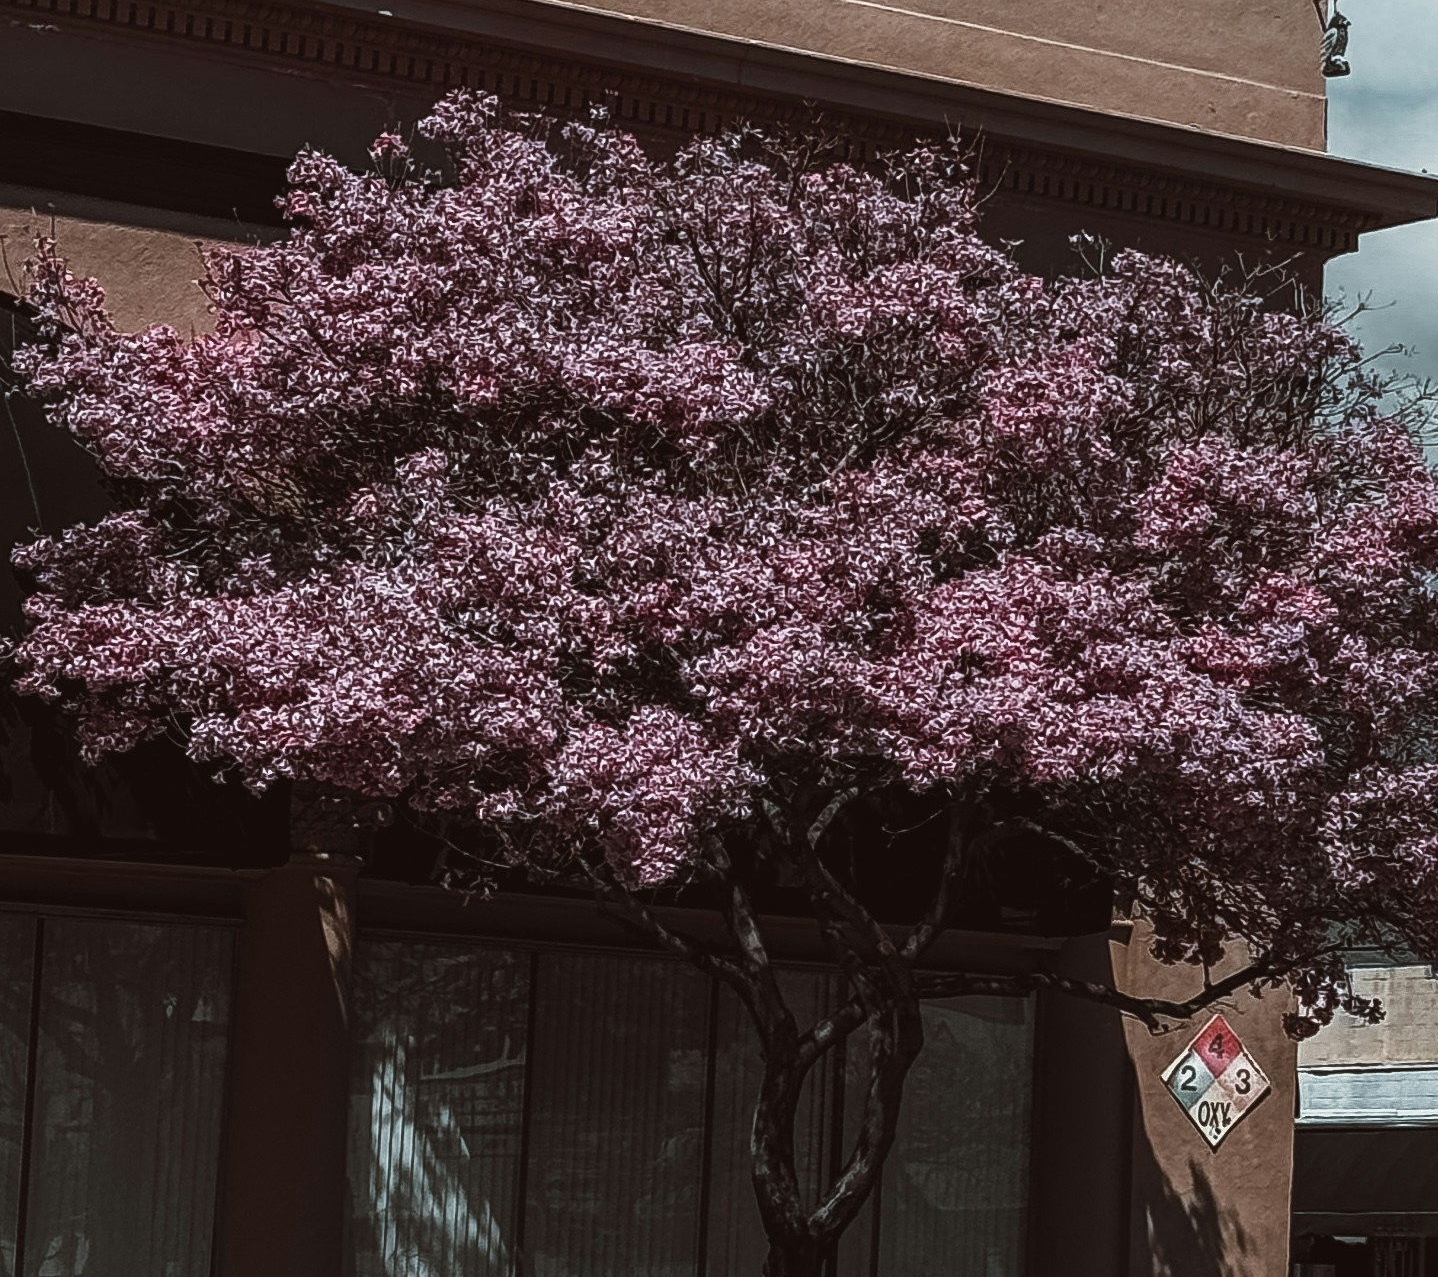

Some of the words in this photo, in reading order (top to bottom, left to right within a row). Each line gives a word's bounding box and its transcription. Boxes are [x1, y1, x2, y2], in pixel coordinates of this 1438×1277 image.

[1208, 1033, 1224, 1058] 4
[1180, 1065, 1197, 1091] 2
[1234, 1069, 1251, 1094] 3
